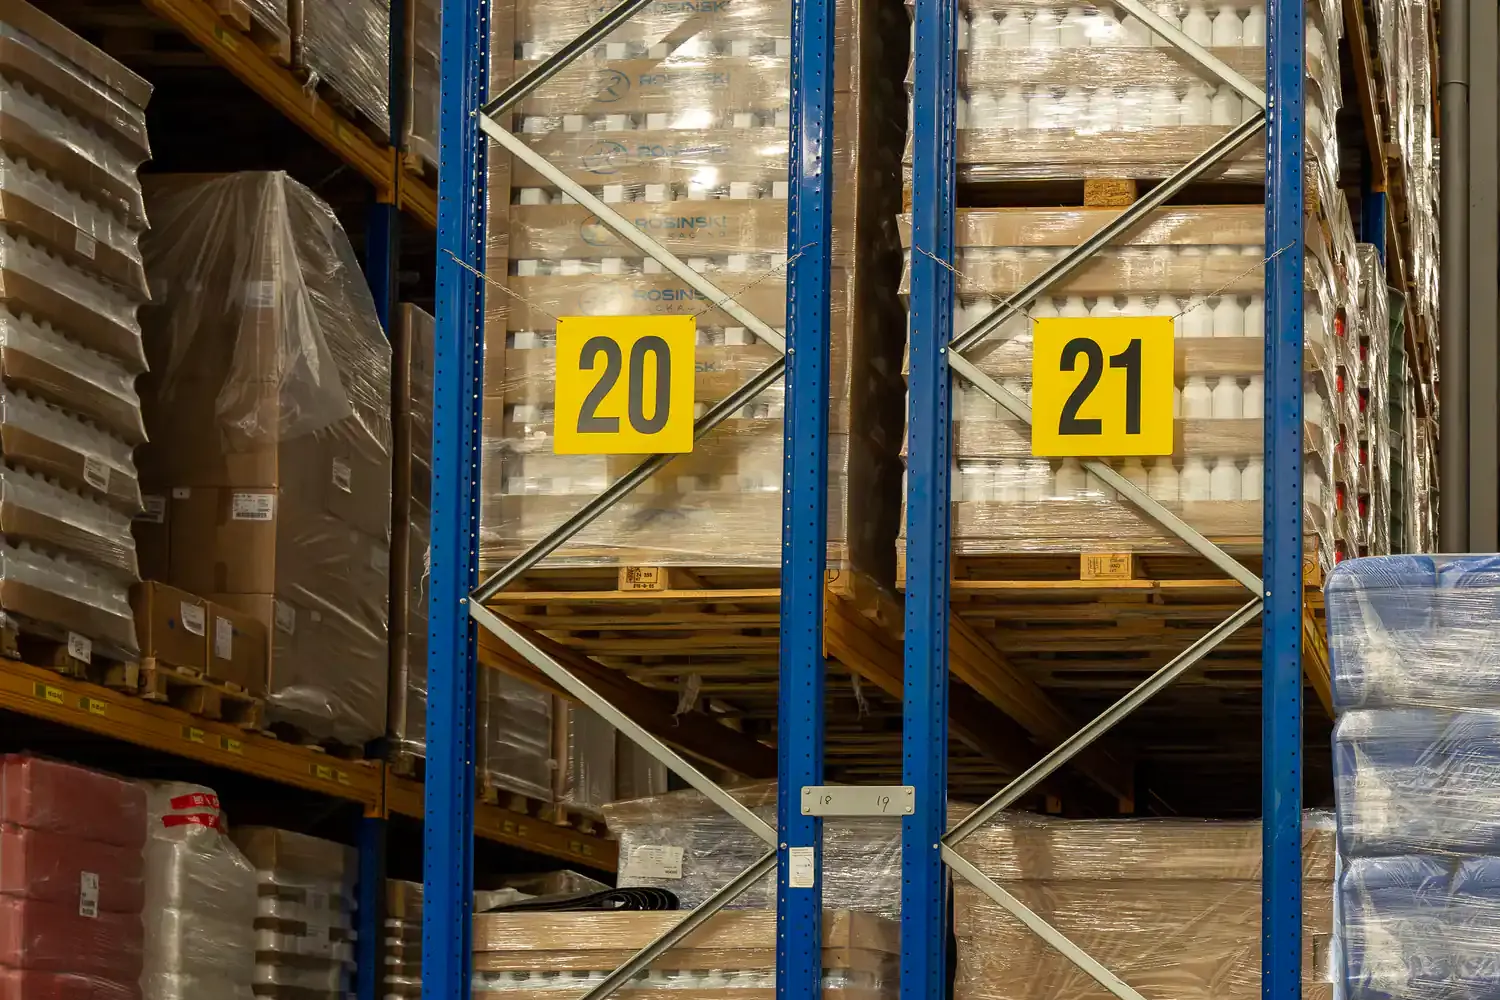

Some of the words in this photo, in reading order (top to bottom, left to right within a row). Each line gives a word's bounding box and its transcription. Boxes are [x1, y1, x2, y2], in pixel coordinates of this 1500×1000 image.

[577, 335, 671, 434] 20
[1058, 338, 1142, 436] 21
[819, 795, 832, 805] 18
[876, 795, 890, 813] 19
